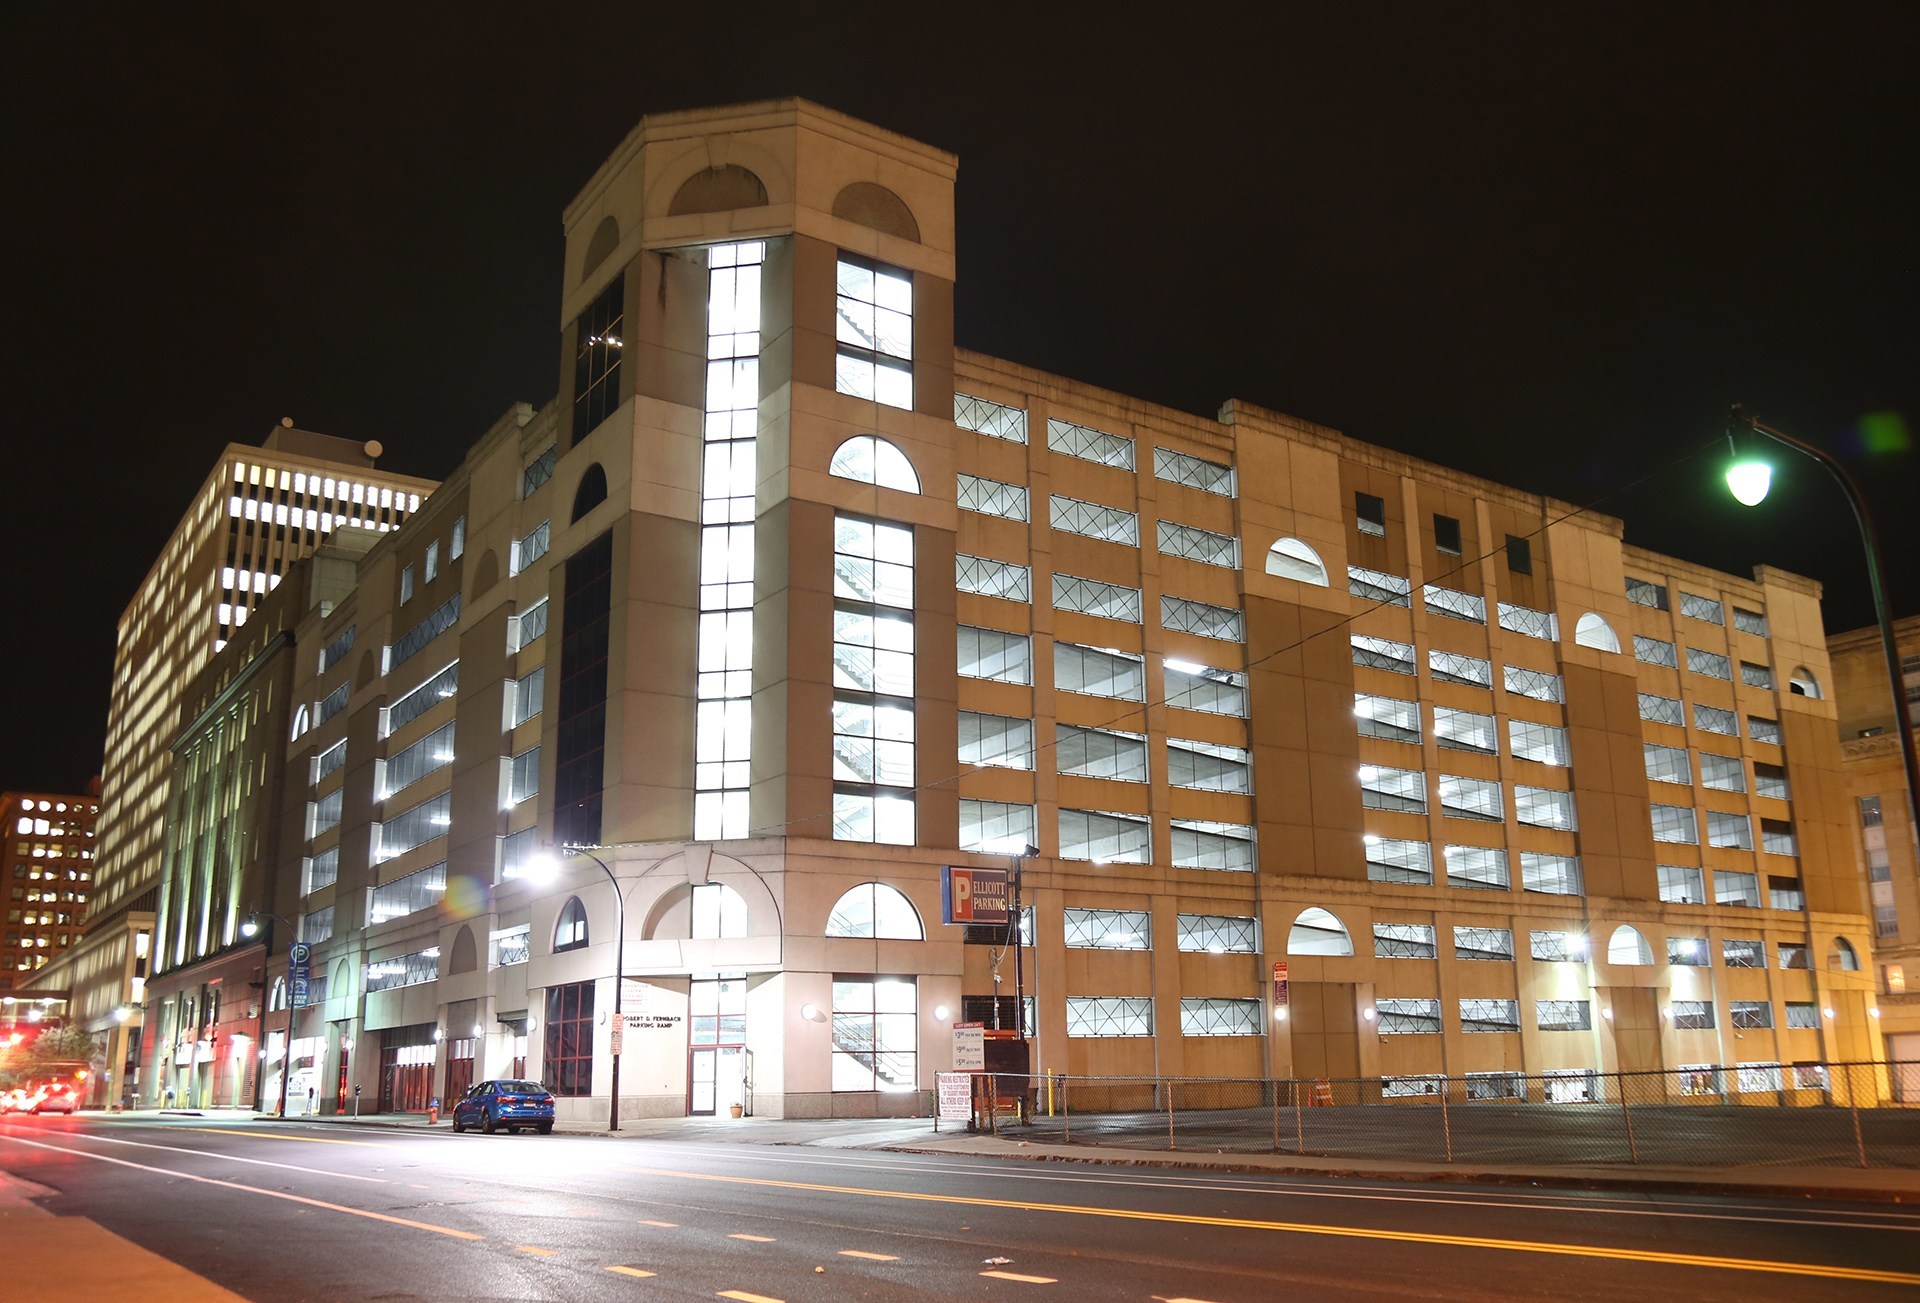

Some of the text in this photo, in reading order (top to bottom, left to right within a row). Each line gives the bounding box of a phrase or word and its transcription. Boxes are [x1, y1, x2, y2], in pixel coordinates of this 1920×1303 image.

[955, 877, 970, 913] P
[973, 881, 1005, 895] ELLICOTT
[973, 898, 1006, 911] PARKING
